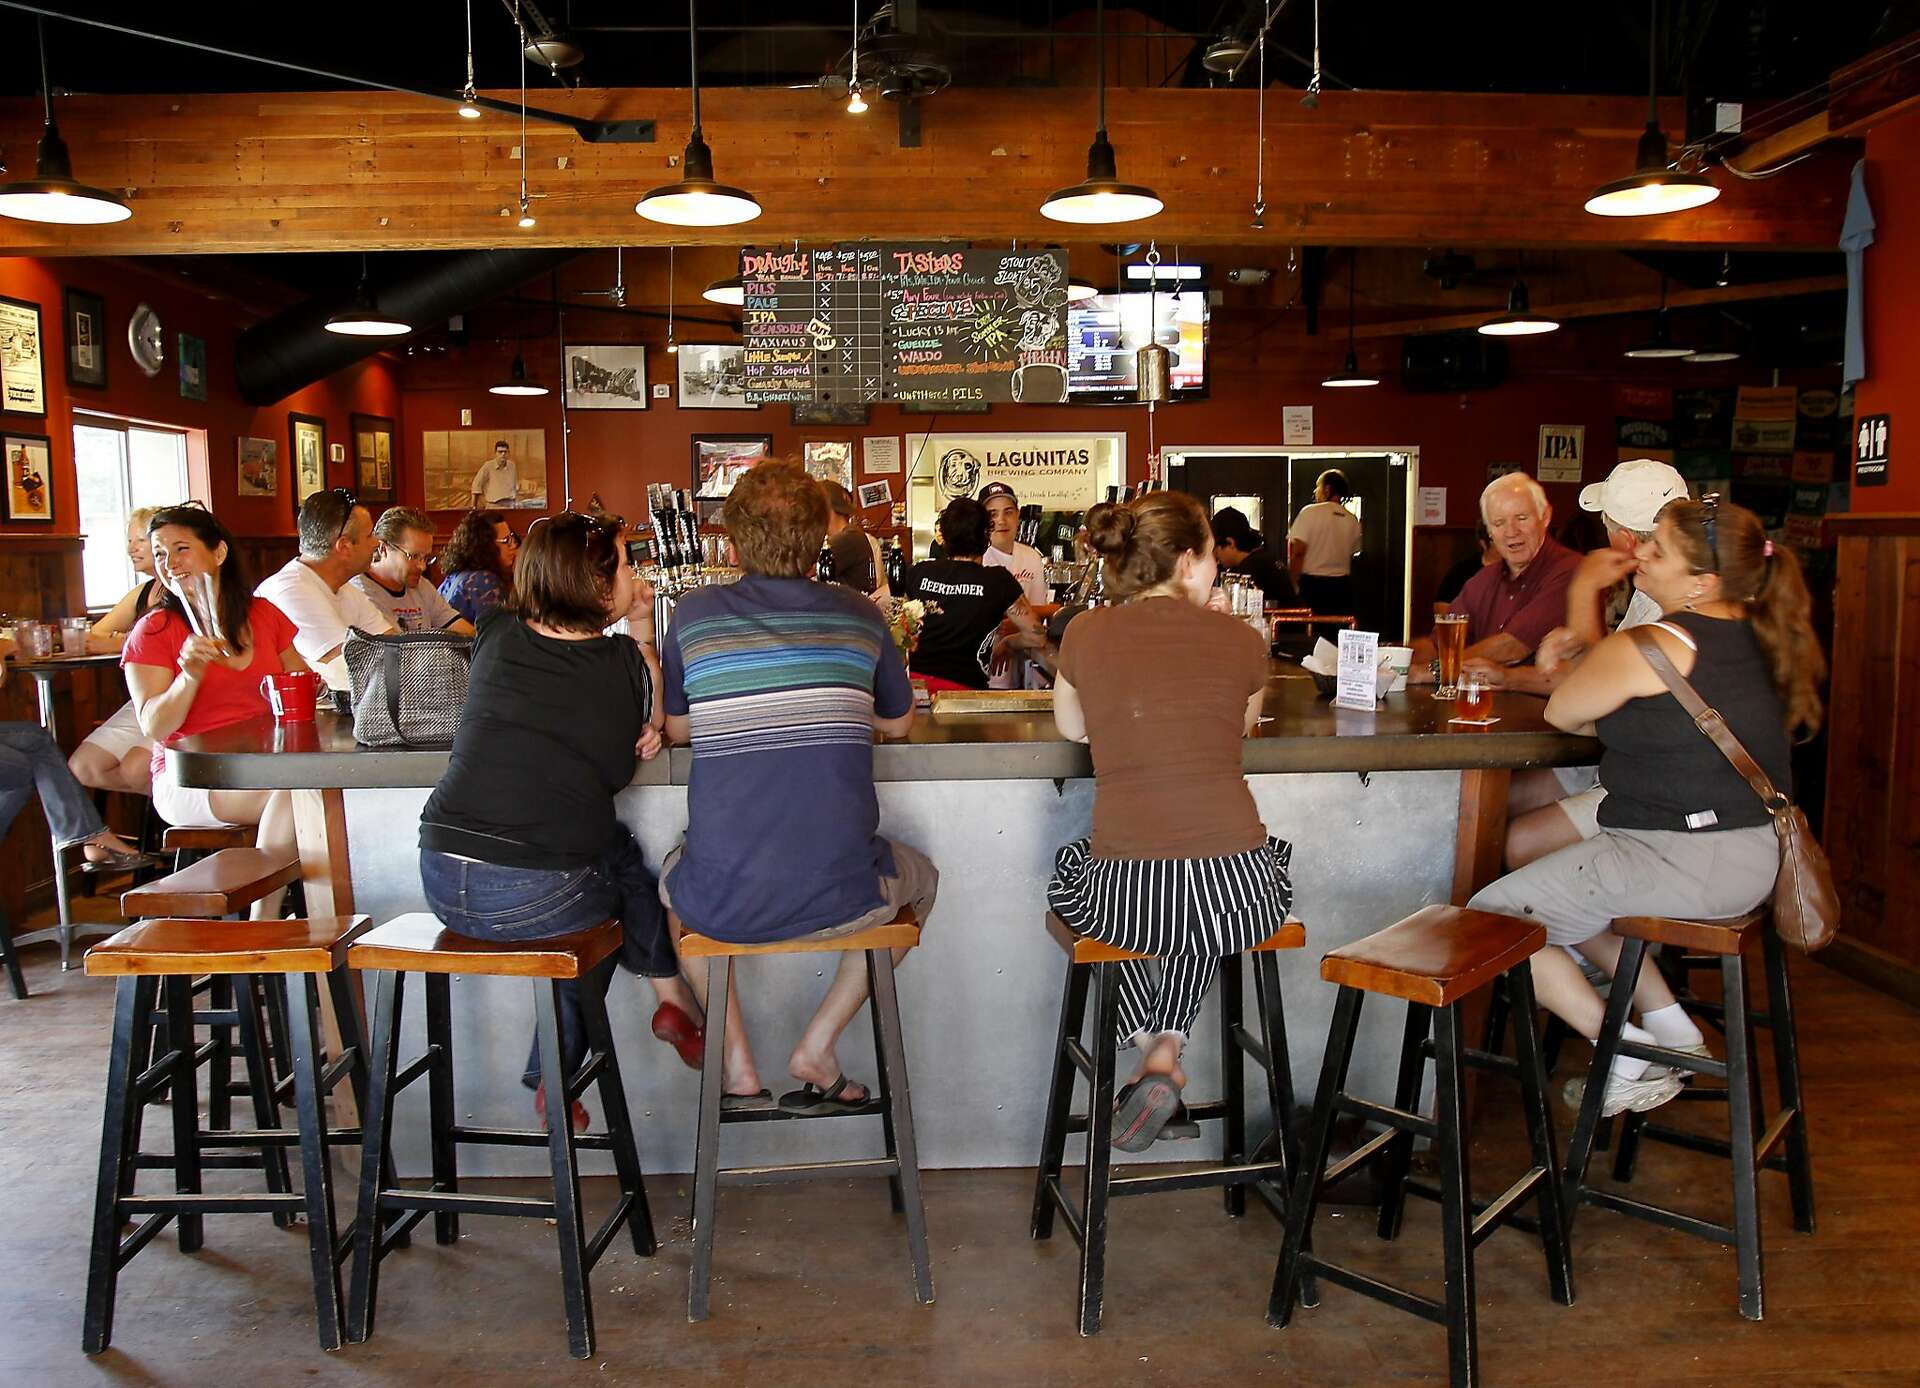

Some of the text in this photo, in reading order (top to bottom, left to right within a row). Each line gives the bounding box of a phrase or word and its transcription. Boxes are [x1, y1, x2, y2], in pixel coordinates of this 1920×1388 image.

[999, 256, 1034, 270] STOUT
[746, 282, 777, 295] PILS
[747, 297, 779, 309] PALE
[749, 311, 777, 324] IPA
[750, 323, 810, 335] CENSORE
[748, 337, 807, 348] MAXIMUS
[899, 351, 943, 364] WALDO
[952, 388, 984, 400] PILS
[1544, 435, 1578, 459] IPA
[986, 449, 1090, 467] LAGUNITAS
[1039, 468, 1089, 476] COMPANY
[919, 577, 984, 597] BEERTENDER
